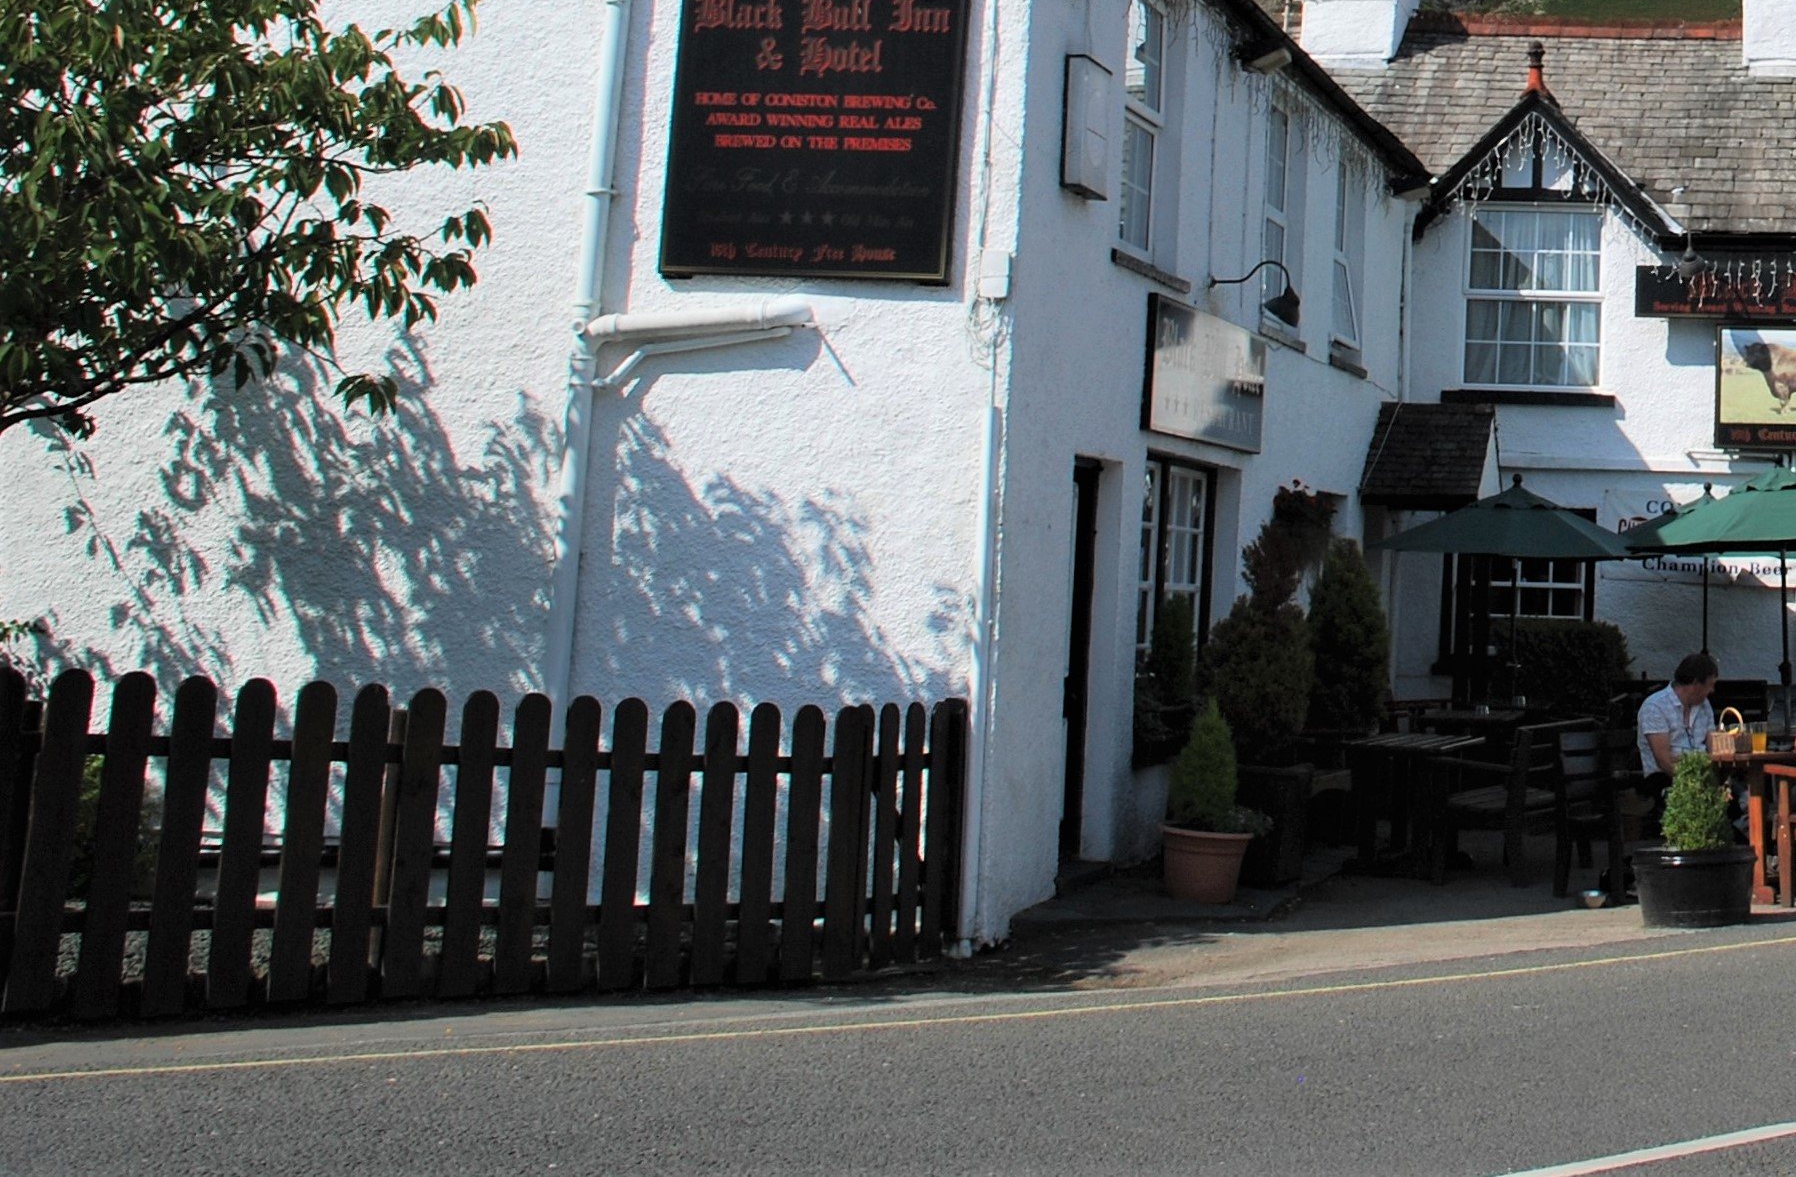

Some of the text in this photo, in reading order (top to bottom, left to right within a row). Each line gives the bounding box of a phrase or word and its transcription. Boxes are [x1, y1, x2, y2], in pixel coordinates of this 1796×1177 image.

[756, 36, 883, 78] & Hotel
[694, 92, 738, 106] HOME
[741, 93, 761, 106] OF
[764, 93, 839, 109] CONISTON
[843, 95, 912, 110] BREWING
[706, 112, 922, 131] AWARD WINNING REAL ALES
[715, 134, 912, 152] BREWED ON THE PREMISES
[746, 243, 804, 263] Century
